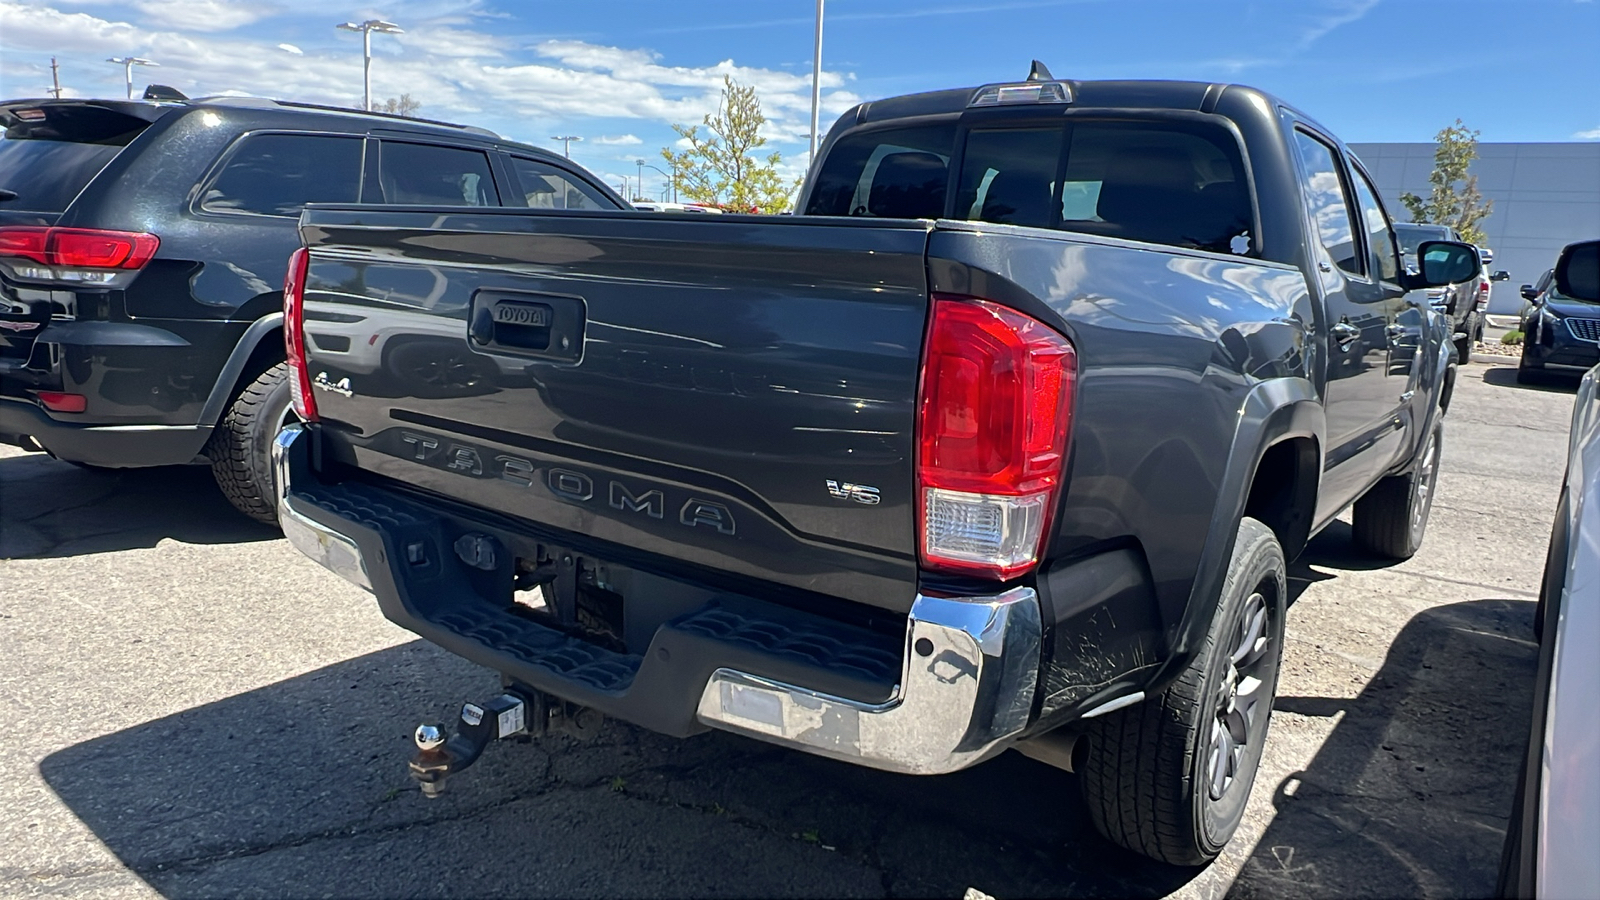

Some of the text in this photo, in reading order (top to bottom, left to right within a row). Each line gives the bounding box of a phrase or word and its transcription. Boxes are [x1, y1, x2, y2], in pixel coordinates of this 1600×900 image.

[498, 306, 546, 325] TOYOTA
[401, 431, 736, 535] TACOMA
[825, 479, 881, 505] V6
